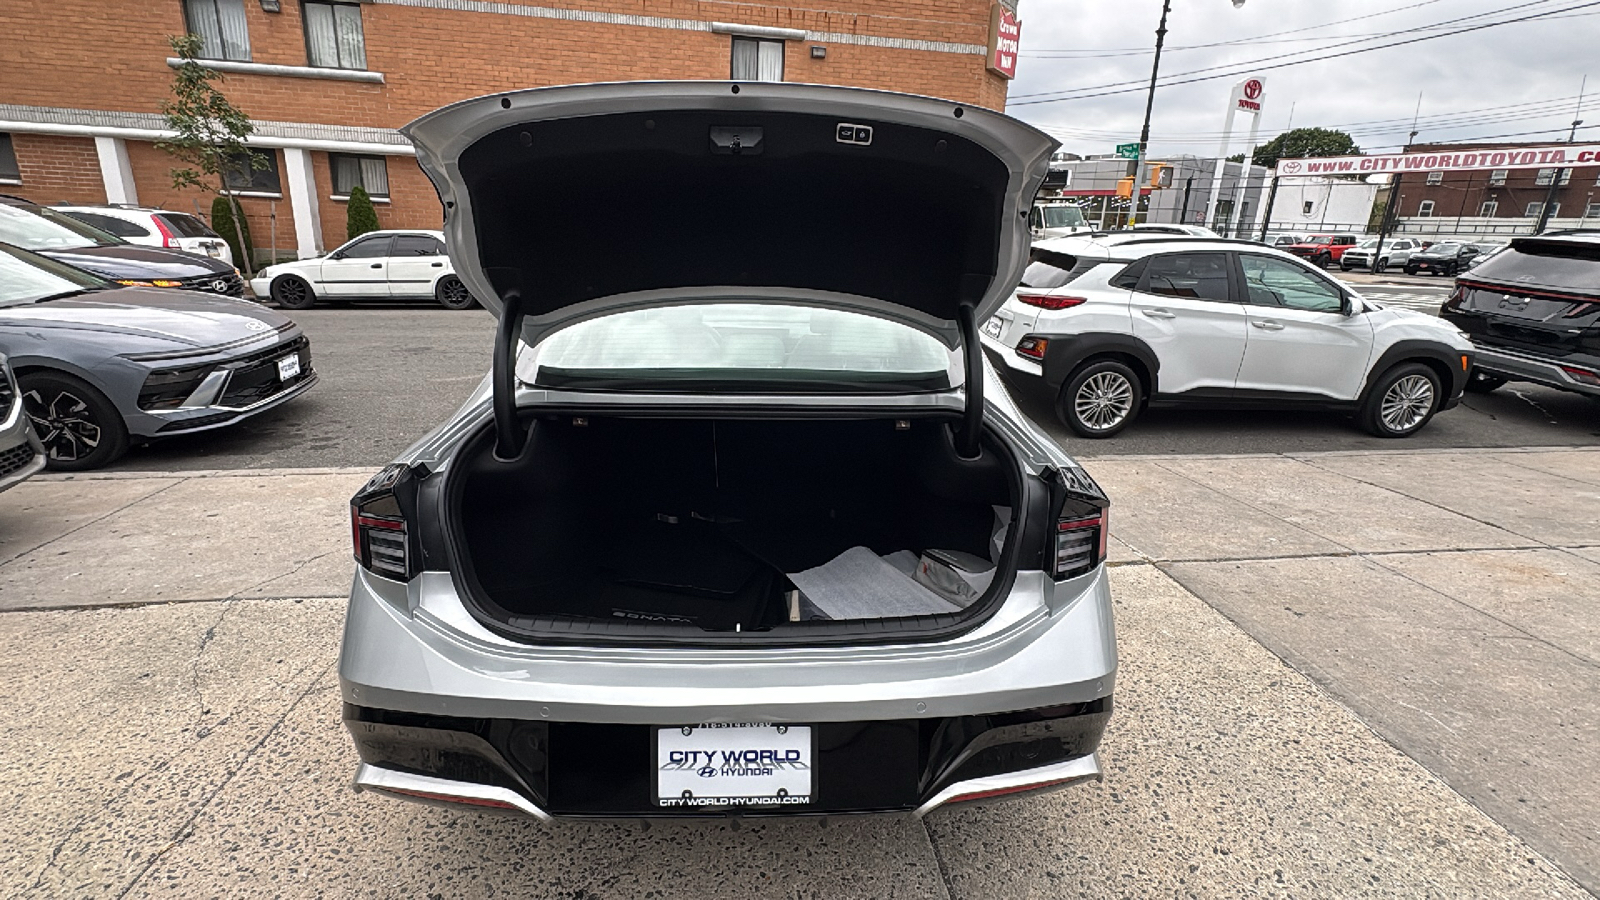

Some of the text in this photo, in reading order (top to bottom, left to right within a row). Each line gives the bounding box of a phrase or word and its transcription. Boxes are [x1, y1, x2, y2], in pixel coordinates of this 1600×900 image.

[997, 36, 1018, 53] MOTOR
[1238, 99, 1260, 110] TOYOTA
[612, 611, 692, 623] SONATA
[669, 750, 800, 762] CITY WORLD
[721, 768, 773, 776] HYUNDAI
[687, 798, 729, 806] WORLD
[730, 797, 810, 805] HYUNDAI.COM
